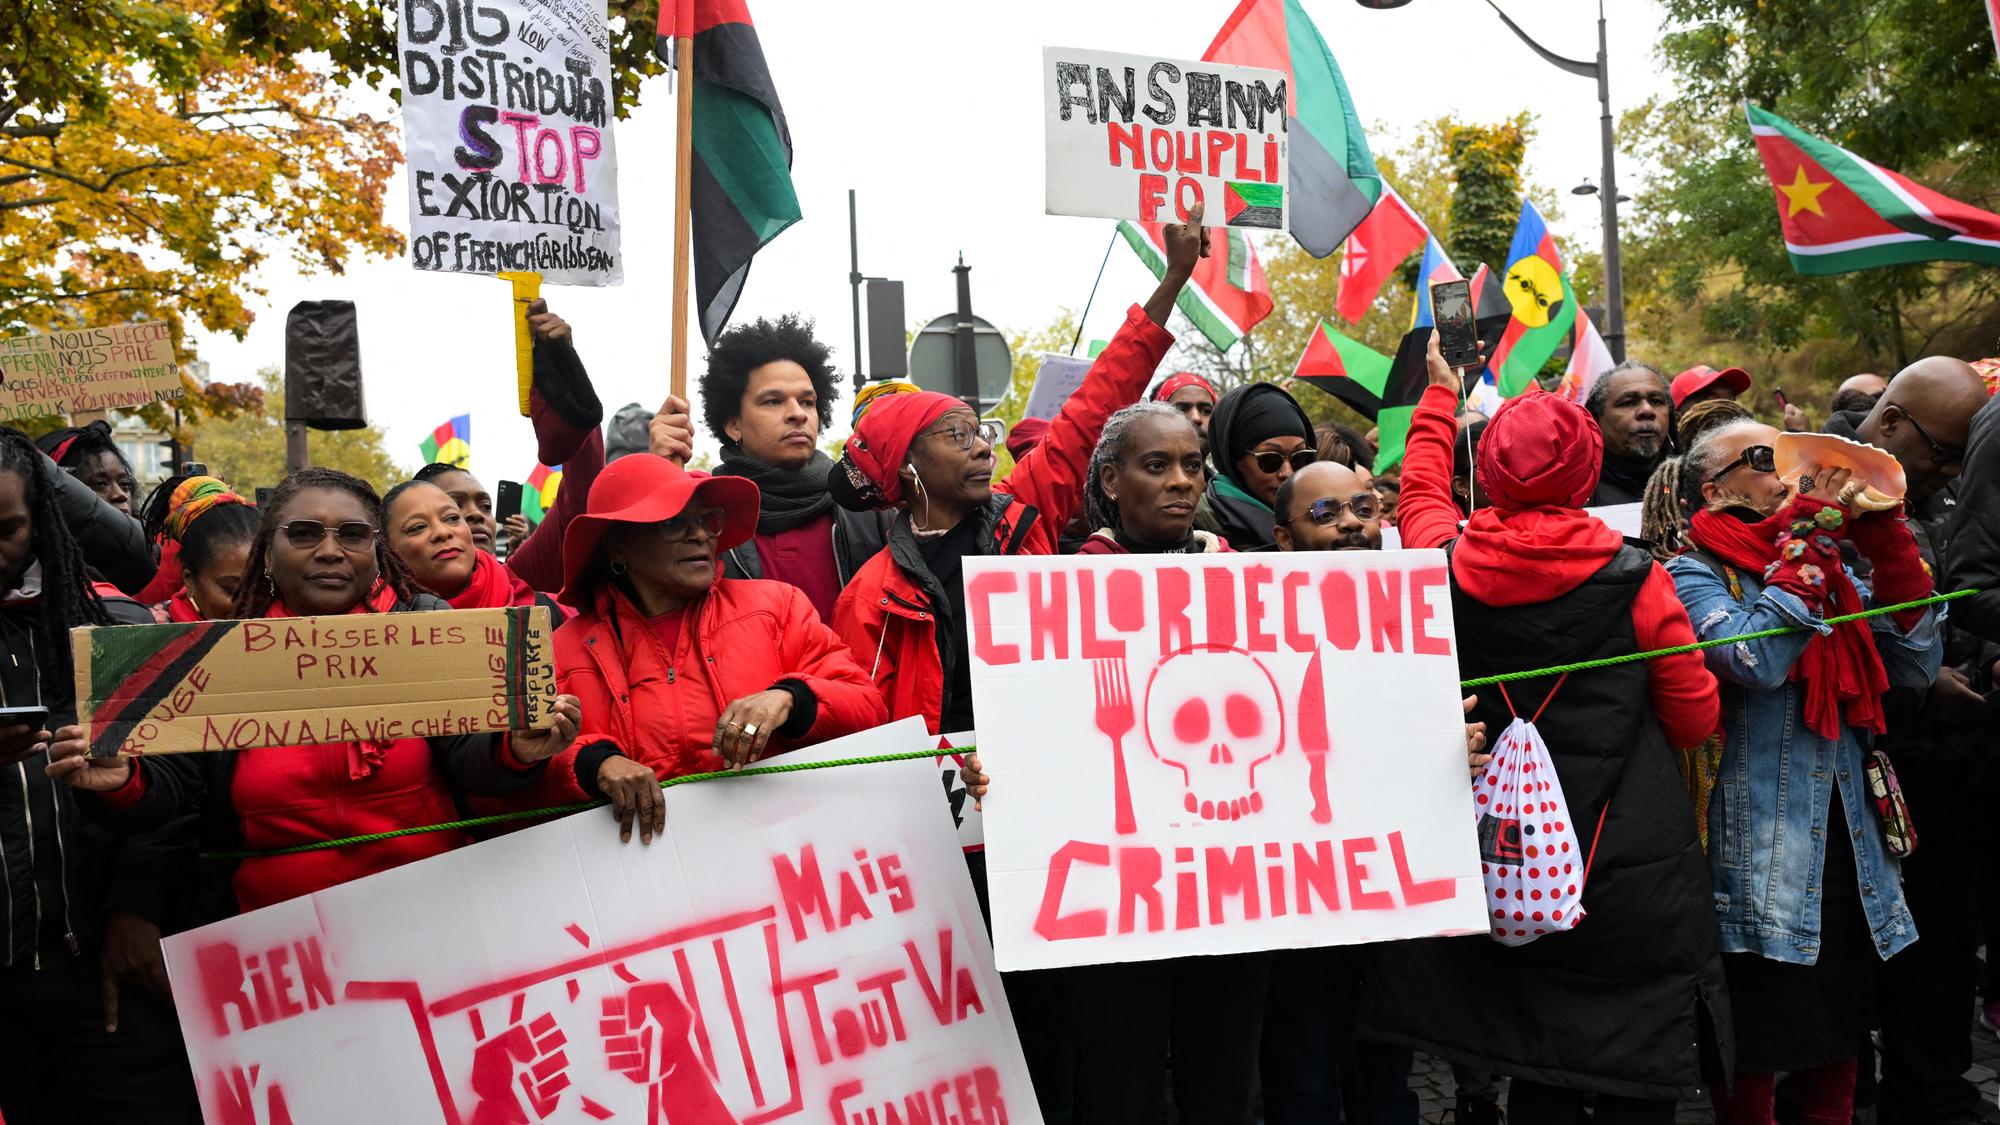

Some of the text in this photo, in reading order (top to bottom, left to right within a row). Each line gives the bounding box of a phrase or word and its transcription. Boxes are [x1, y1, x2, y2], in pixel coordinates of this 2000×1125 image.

[517, 20, 553, 52] NOW
[1056, 61, 1288, 134] ANSANM
[454, 105, 603, 193] STOP
[413, 231, 450, 271] OF
[452, 232, 536, 272] FRENCH
[50, 329, 113, 350] NOUS
[59, 347, 108, 367] NOUS
[2, 378, 39, 392] NOUS
[411, 625, 466, 647] LES
[296, 653, 378, 680] PRIX
[485, 626, 511, 729] ROUGE
[119, 665, 212, 755] ROUGE
[903, 928, 986, 1026] VA
